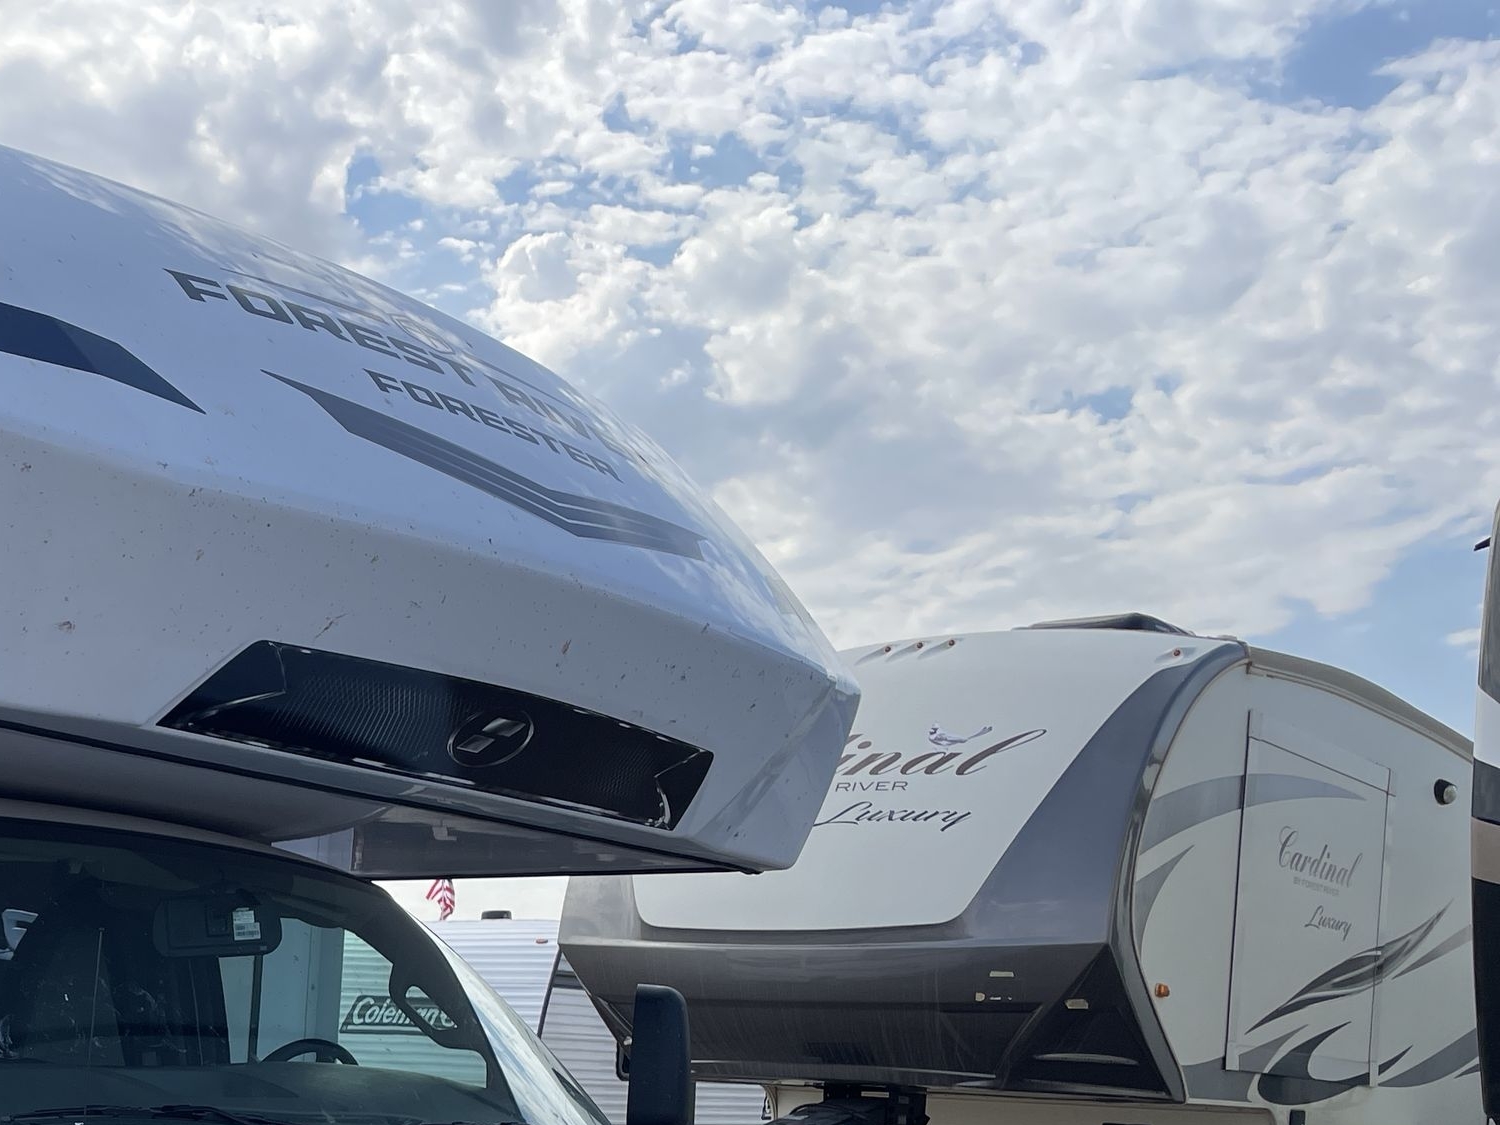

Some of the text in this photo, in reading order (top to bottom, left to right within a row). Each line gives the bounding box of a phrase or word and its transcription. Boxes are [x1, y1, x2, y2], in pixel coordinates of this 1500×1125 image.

[162, 267, 477, 388] FOREST
[362, 368, 625, 484] FORESTER
[835, 729, 1047, 776] inal
[835, 781, 909, 793] RIVER
[812, 801, 972, 832] Luxury
[1279, 825, 1363, 888] Cardinal
[1304, 904, 1352, 942] Luxury
